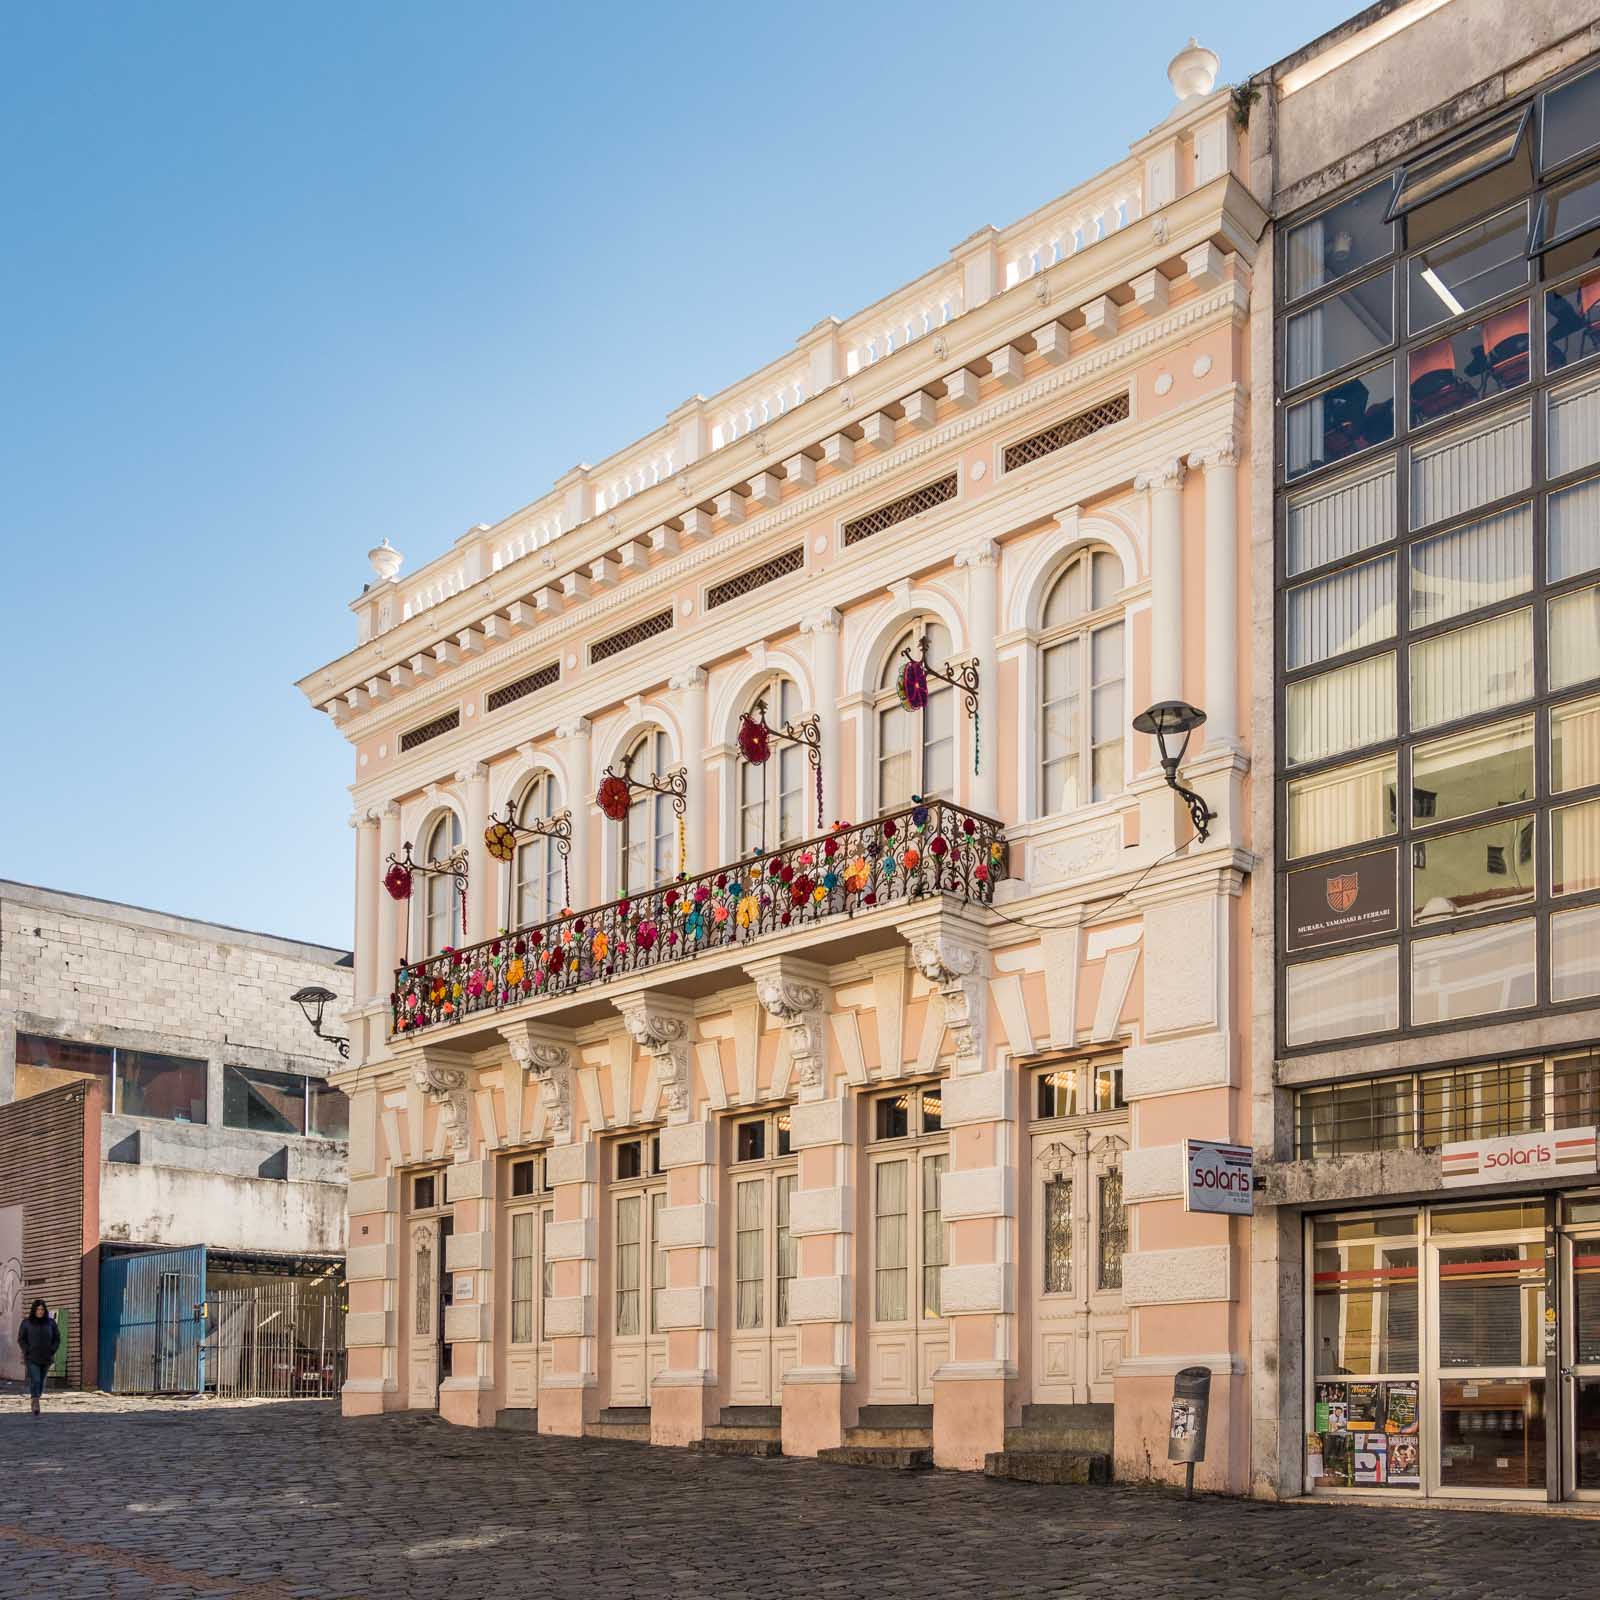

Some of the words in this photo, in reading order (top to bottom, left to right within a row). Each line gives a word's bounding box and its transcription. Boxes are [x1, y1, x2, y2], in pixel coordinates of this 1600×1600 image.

[1363, 908, 1390, 919] FERRARI
[1484, 1144, 1551, 1168] solaris
[1193, 1165, 1249, 1192] solaris
